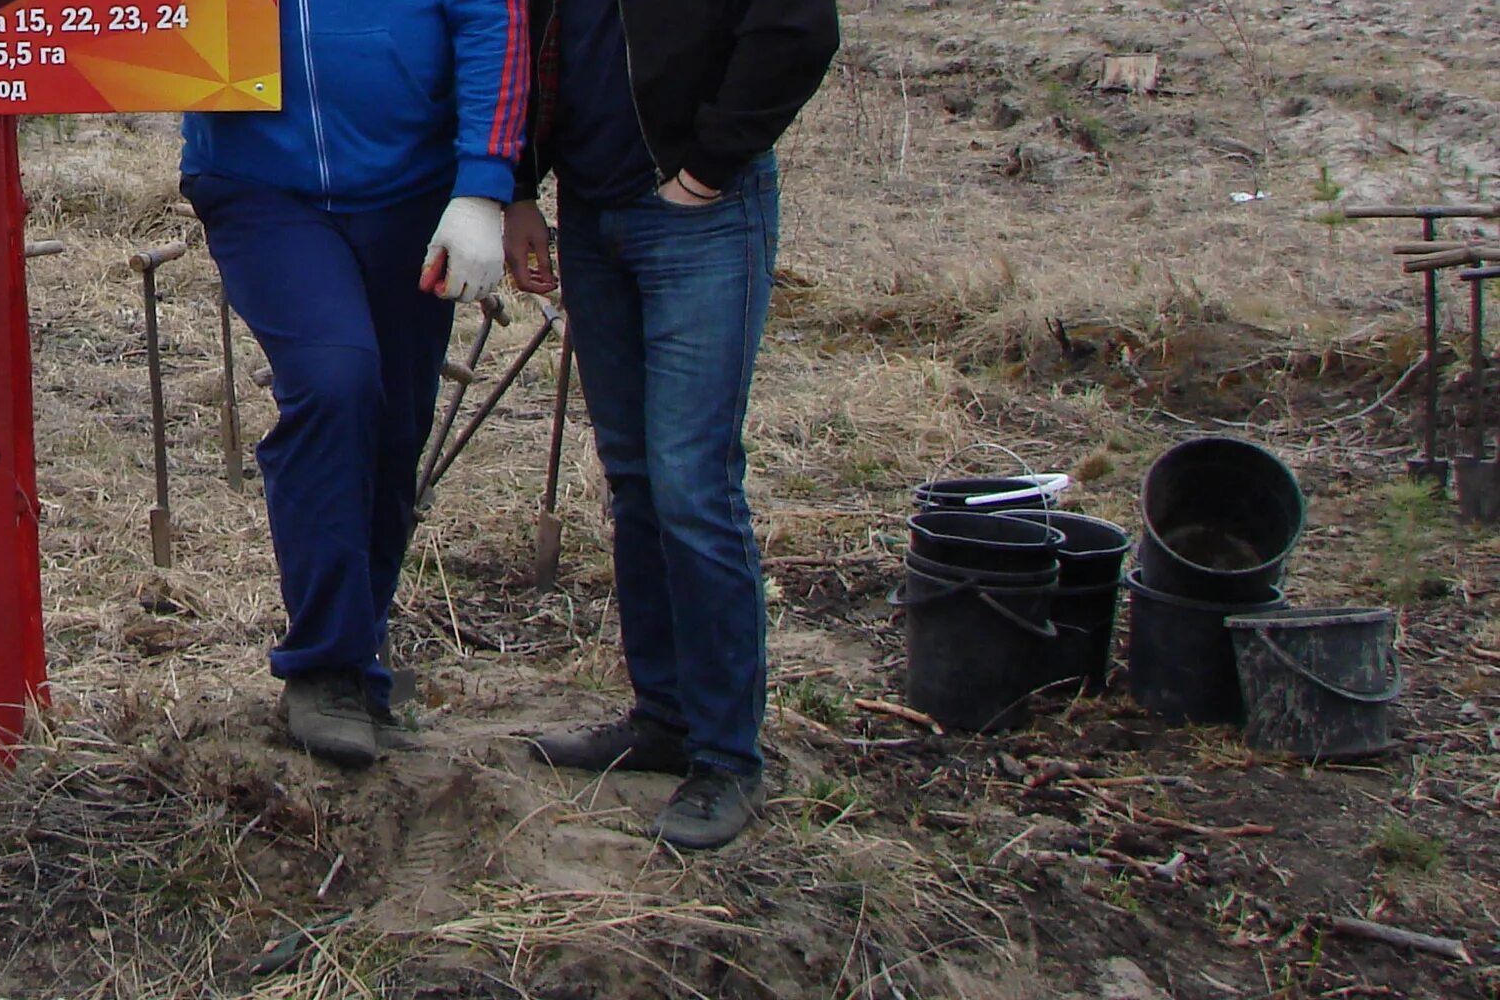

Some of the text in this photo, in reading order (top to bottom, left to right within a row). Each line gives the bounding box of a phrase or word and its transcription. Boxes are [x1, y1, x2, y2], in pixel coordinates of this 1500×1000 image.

[15, 9, 53, 35] 15,
[61, 7, 101, 34] 22,
[108, 6, 148, 33] 23,
[156, 5, 188, 29] 24
[40, 47, 66, 64] га
